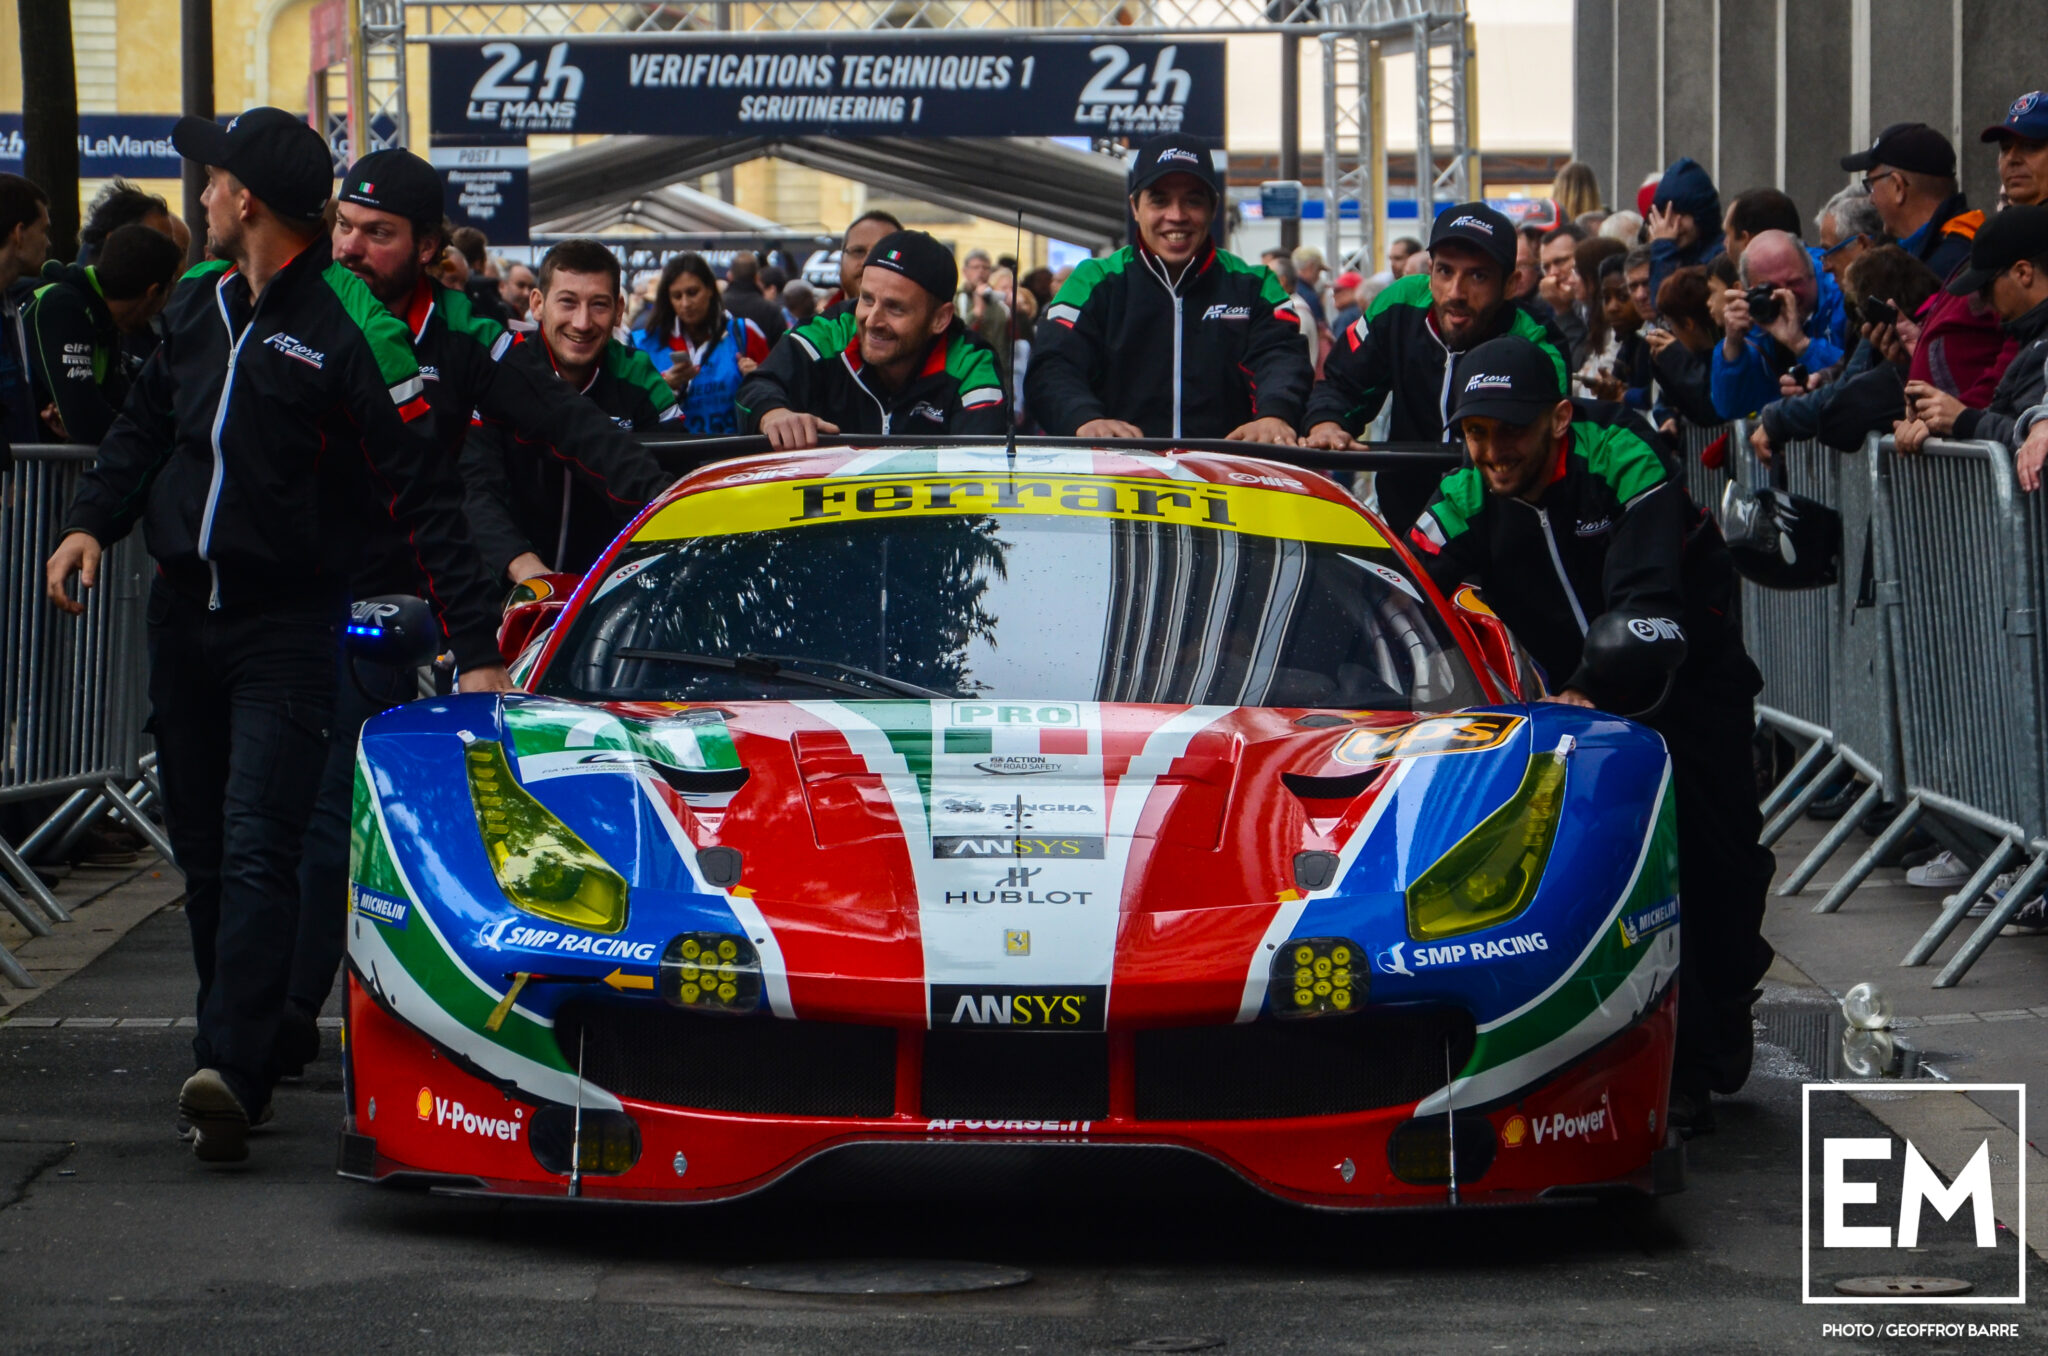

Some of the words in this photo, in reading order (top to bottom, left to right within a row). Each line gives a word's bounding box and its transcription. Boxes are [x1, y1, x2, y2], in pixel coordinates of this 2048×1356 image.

[470, 42, 584, 100] 24h
[629, 54, 836, 87] VERIFICATIONS
[841, 55, 1013, 89] TECHNIQUES
[1020, 55, 1035, 88] 1
[1079, 44, 1191, 103] 24h
[466, 101, 499, 119] LE
[501, 101, 577, 119] MANS
[738, 95, 906, 121] SCRUTINEERING
[911, 95, 924, 121] 1
[1074, 104, 1109, 122] LE
[1109, 104, 1185, 122] MANS
[459, 150, 489, 162] POST
[789, 481, 1237, 527] Ferrari
[960, 705, 1073, 725] PRO
[990, 803, 1096, 812] SINGHA
[953, 839, 1081, 855] ANSYS
[360, 893, 406, 920] MICHELIN
[945, 891, 1093, 905] HUBLOT
[1639, 900, 1677, 931] MICHELIN
[504, 926, 559, 947] SMP
[556, 933, 656, 961] RACING
[1413, 945, 1467, 967] SMP
[1469, 932, 1549, 960] RACING
[951, 994, 1086, 1026] ANSYS
[435, 1096, 521, 1141] V-Power
[1532, 1107, 1605, 1145] V-Power
